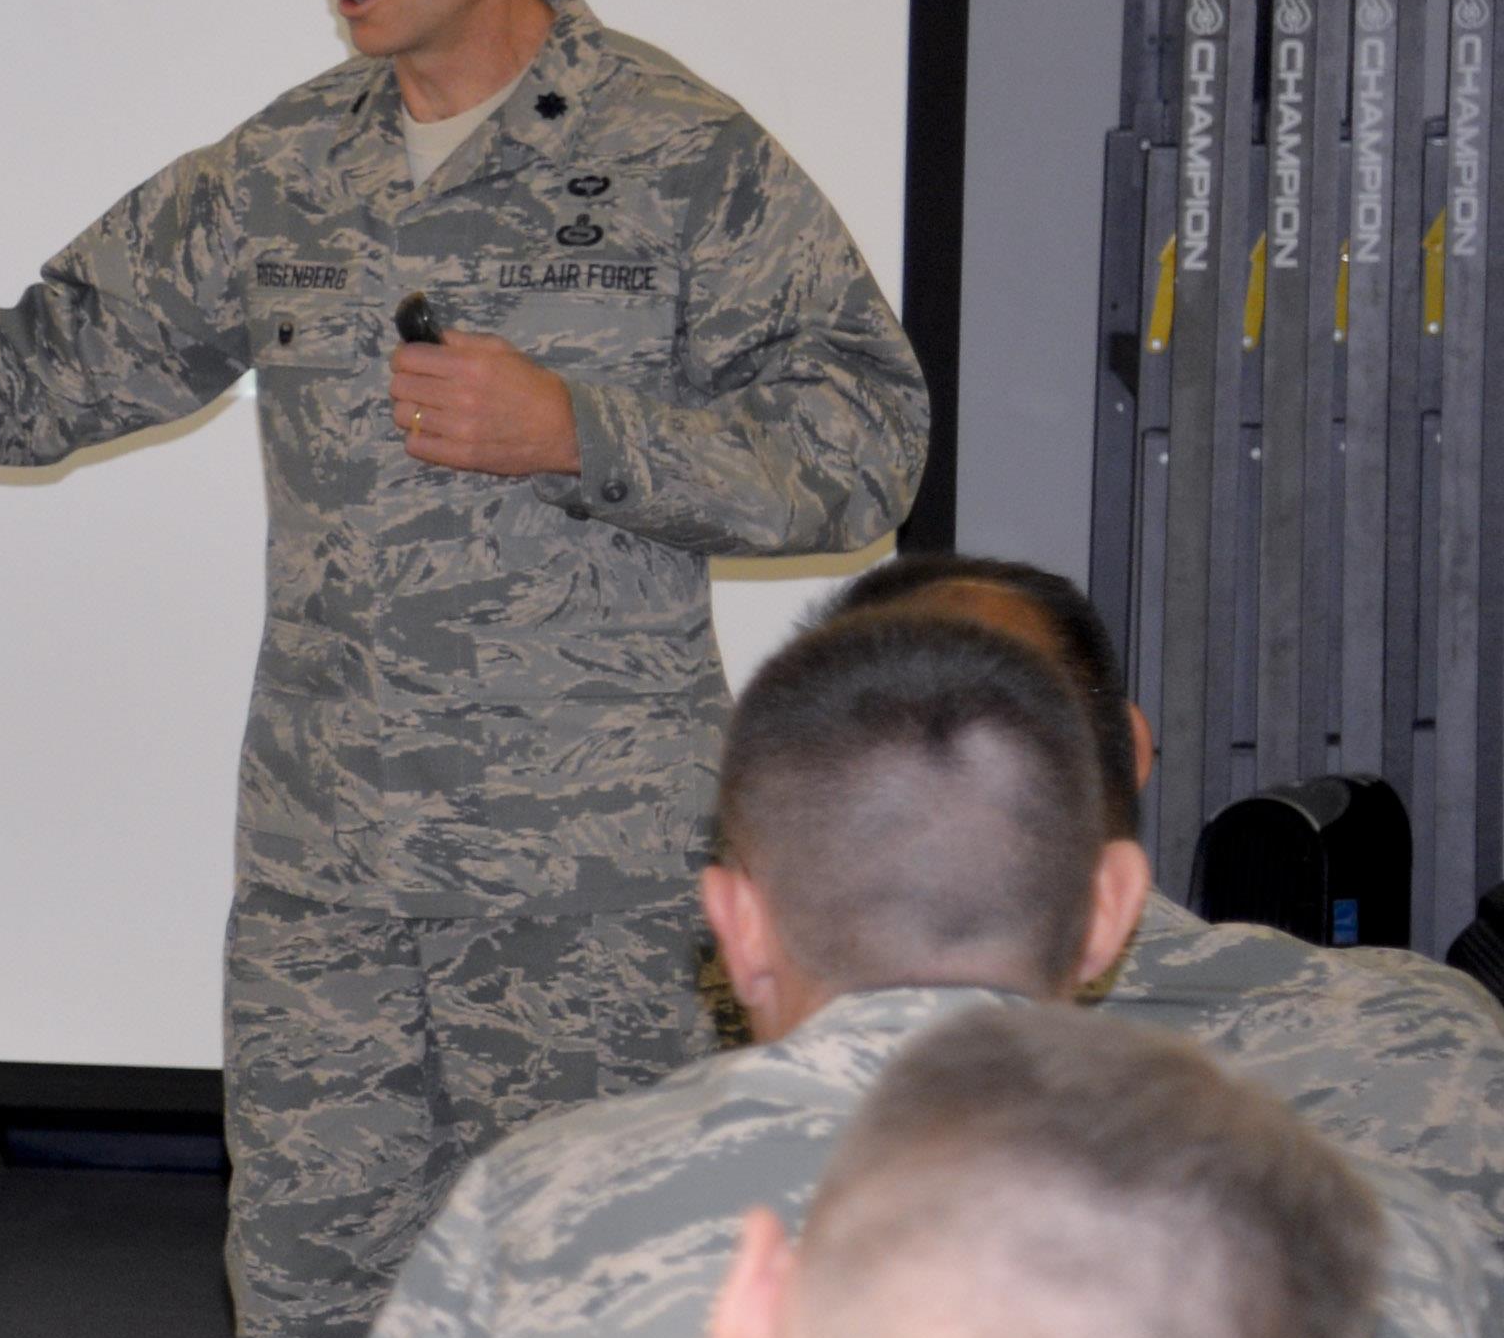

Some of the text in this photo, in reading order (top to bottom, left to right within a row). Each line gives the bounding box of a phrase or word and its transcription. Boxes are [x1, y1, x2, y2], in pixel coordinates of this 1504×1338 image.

[1182, 40, 1216, 270] CHAMPION
[1274, 39, 1305, 268] CHAMPION
[1357, 37, 1386, 262] CHAMPION
[1453, 34, 1483, 256] CHAMPION
[256, 263, 349, 290] ROSENBERG
[499, 263, 658, 291] U.S. AIR FORCE
